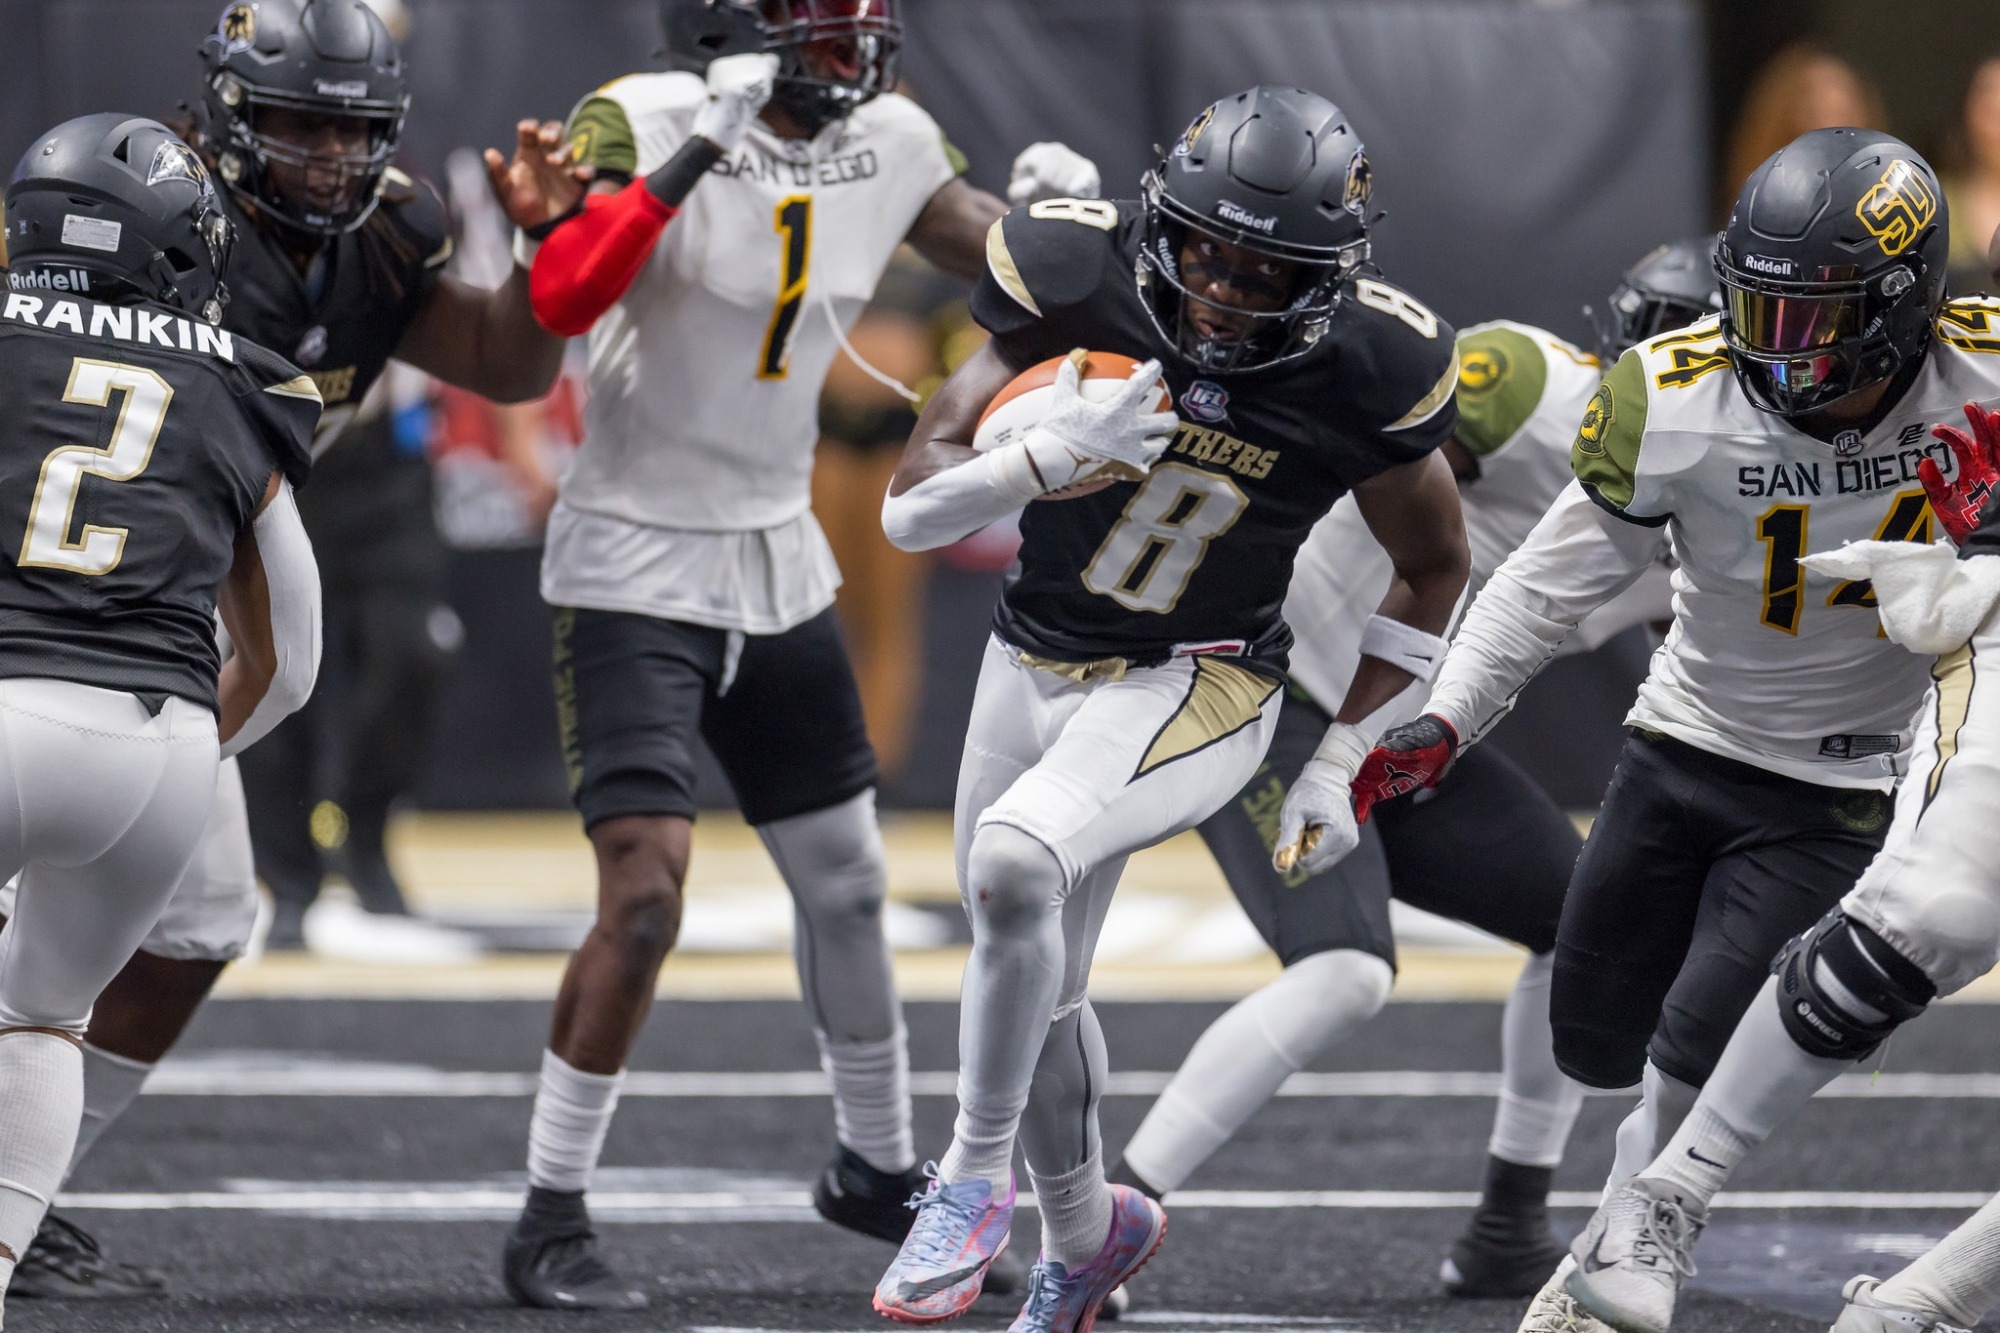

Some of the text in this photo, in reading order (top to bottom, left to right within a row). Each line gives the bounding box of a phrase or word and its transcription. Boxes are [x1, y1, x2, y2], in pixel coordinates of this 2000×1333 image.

[1028, 197, 1119, 232] 8
[1217, 204, 1276, 232] Riddell
[9, 268, 90, 292] Riddell
[756, 194, 814, 380] 1
[1744, 255, 1792, 276] Riddell
[2, 292, 234, 363] RANKIN
[1355, 279, 1439, 339] 8
[1650, 326, 1732, 391] 14
[16, 356, 175, 577] 2
[1172, 420, 1281, 480] THERS
[1738, 462, 1822, 498] SAN
[1079, 461, 1251, 615] 8
